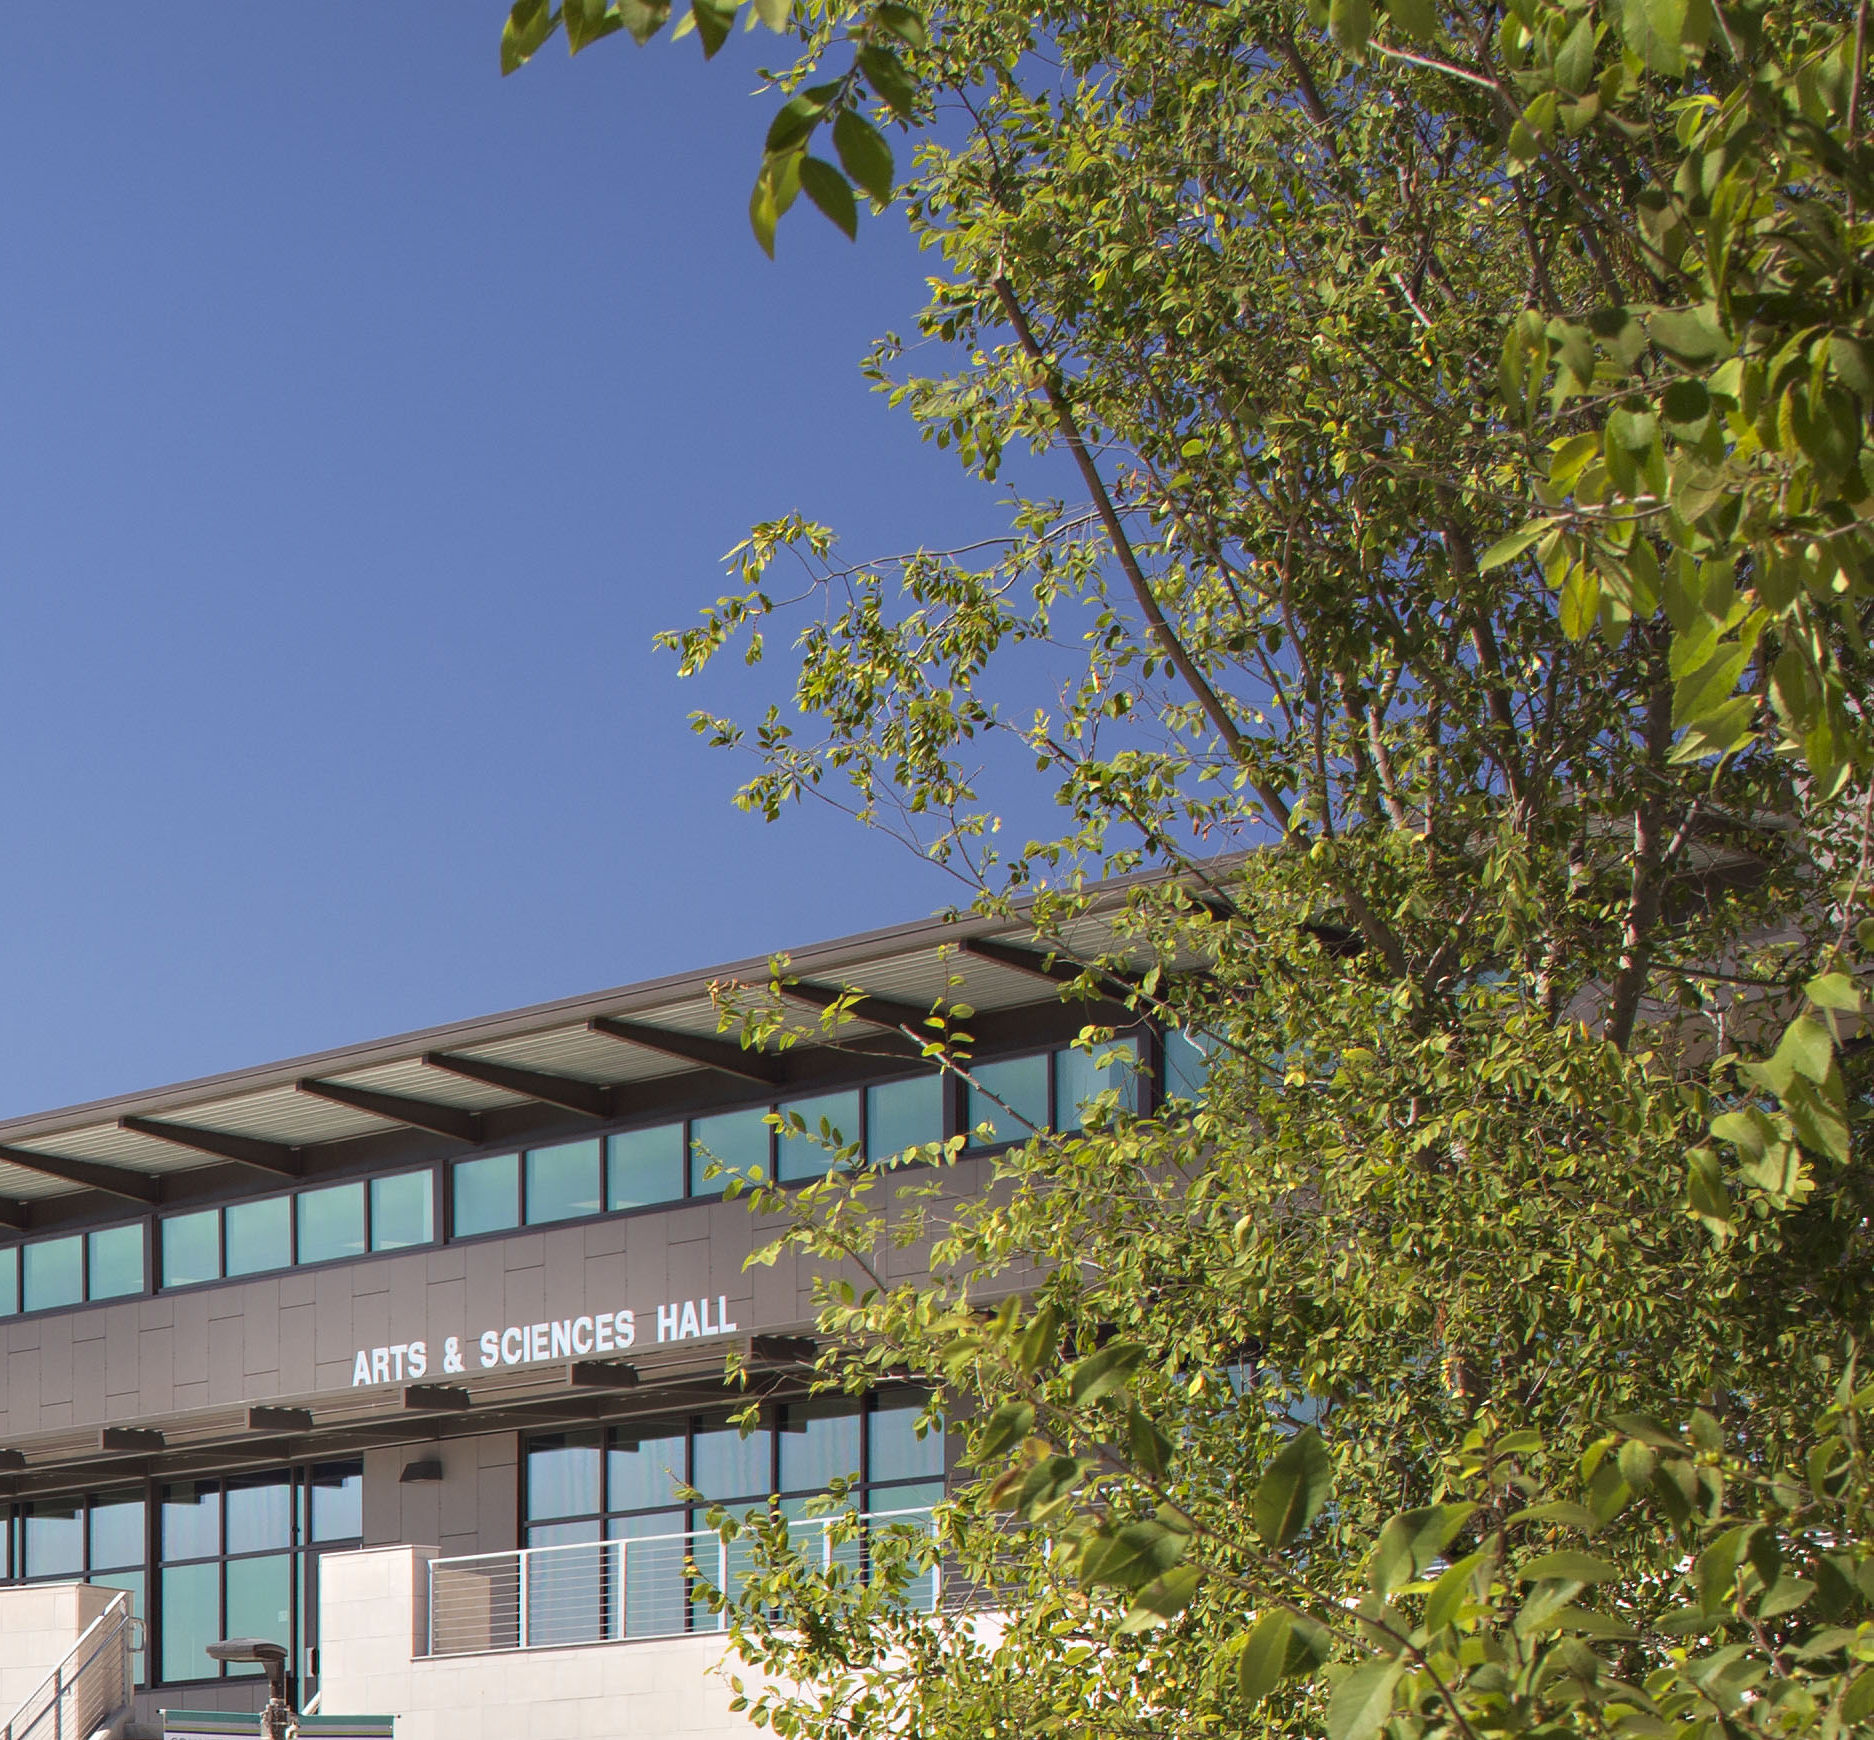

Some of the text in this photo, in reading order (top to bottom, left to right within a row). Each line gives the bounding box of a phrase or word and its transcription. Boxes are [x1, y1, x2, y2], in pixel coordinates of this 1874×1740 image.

[352, 1295, 738, 1386] ARTS & SCIENCES HALL
